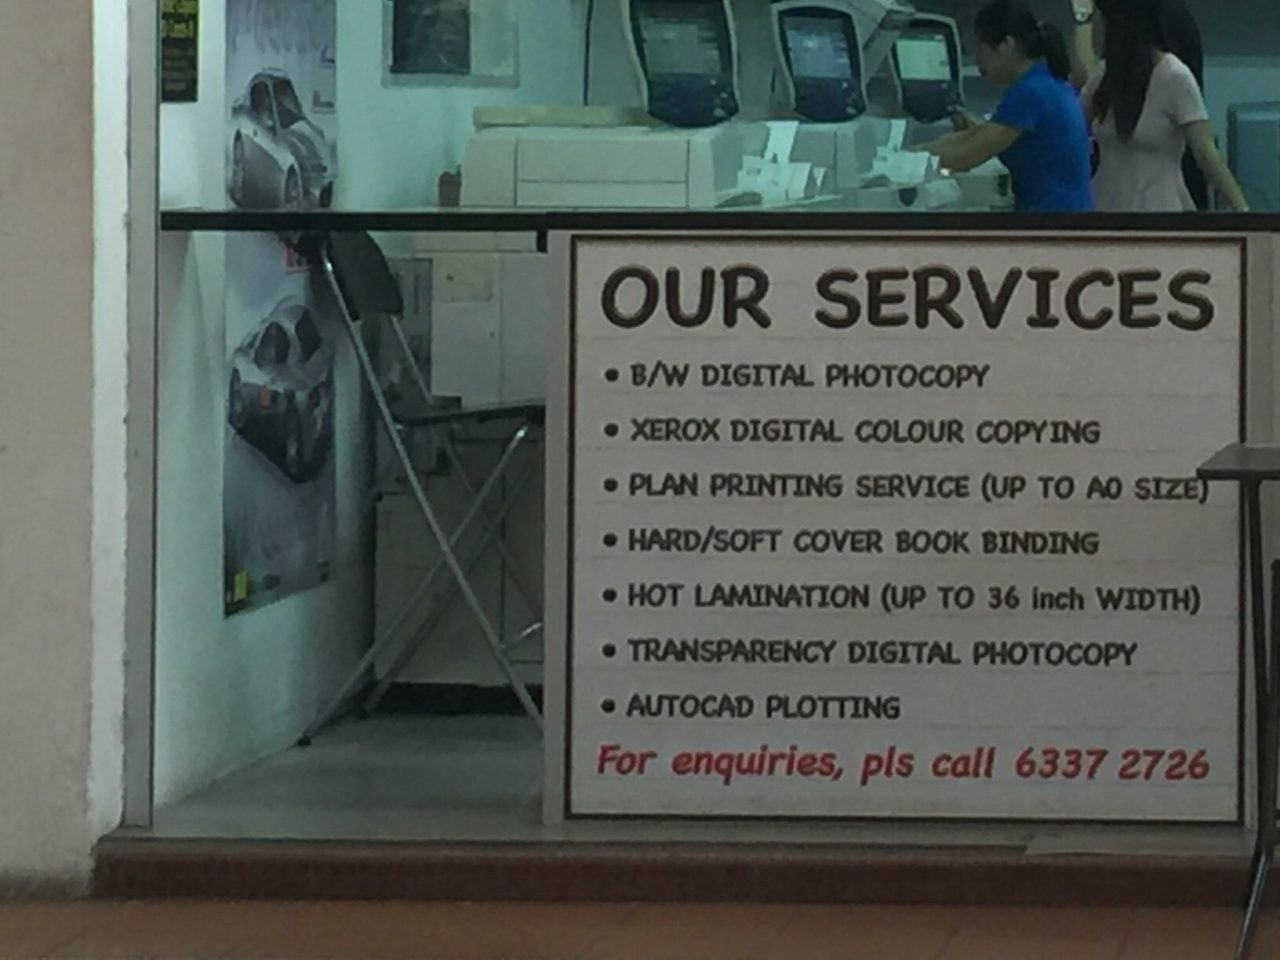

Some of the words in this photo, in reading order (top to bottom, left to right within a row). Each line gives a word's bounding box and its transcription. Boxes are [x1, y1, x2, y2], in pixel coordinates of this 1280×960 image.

[601, 264, 772, 329] OUR
[814, 265, 1215, 332] SERVICES
[630, 360, 690, 388] B/W
[701, 363, 815, 388] DIGITAL
[825, 363, 991, 389] PHOTOCOPY
[630, 417, 721, 442] XEROX
[730, 418, 844, 443] DIGITAL
[854, 419, 965, 445] COLOUR
[976, 420, 1102, 445] COPYING
[628, 472, 699, 496] PLAN
[710, 473, 844, 498] PRINTING
[856, 474, 971, 499] SERVICE
[981, 472, 1027, 503] (UP
[1037, 475, 1076, 500] TO
[1134, 476, 1210, 505] SIZE)
[628, 525, 783, 554] HARD/SOFT
[793, 529, 884, 554] COVER
[895, 530, 971, 555] BOOK
[981, 531, 1100, 556] BINDING
[627, 583, 685, 608] HOT
[694, 583, 870, 609] LAMINATION
[881, 583, 927, 614] (UP
[937, 586, 975, 610] TO
[987, 587, 1020, 611] 36
[1031, 587, 1085, 611] inch
[1095, 586, 1201, 616] WIDTH)
[627, 638, 837, 664] TRANSPARENCY
[847, 640, 962, 665] DIGITAL
[972, 641, 1138, 667] PHOTOCOPY
[626, 694, 754, 719] AUTOCAD
[766, 695, 901, 720] PLOTTING
[597, 744, 658, 775] For
[671, 744, 844, 787] enquiries,
[859, 745, 915, 787] pls
[931, 746, 997, 779] call
[1014, 746, 1110, 780] 6337
[1117, 748, 1211, 781] 2726
